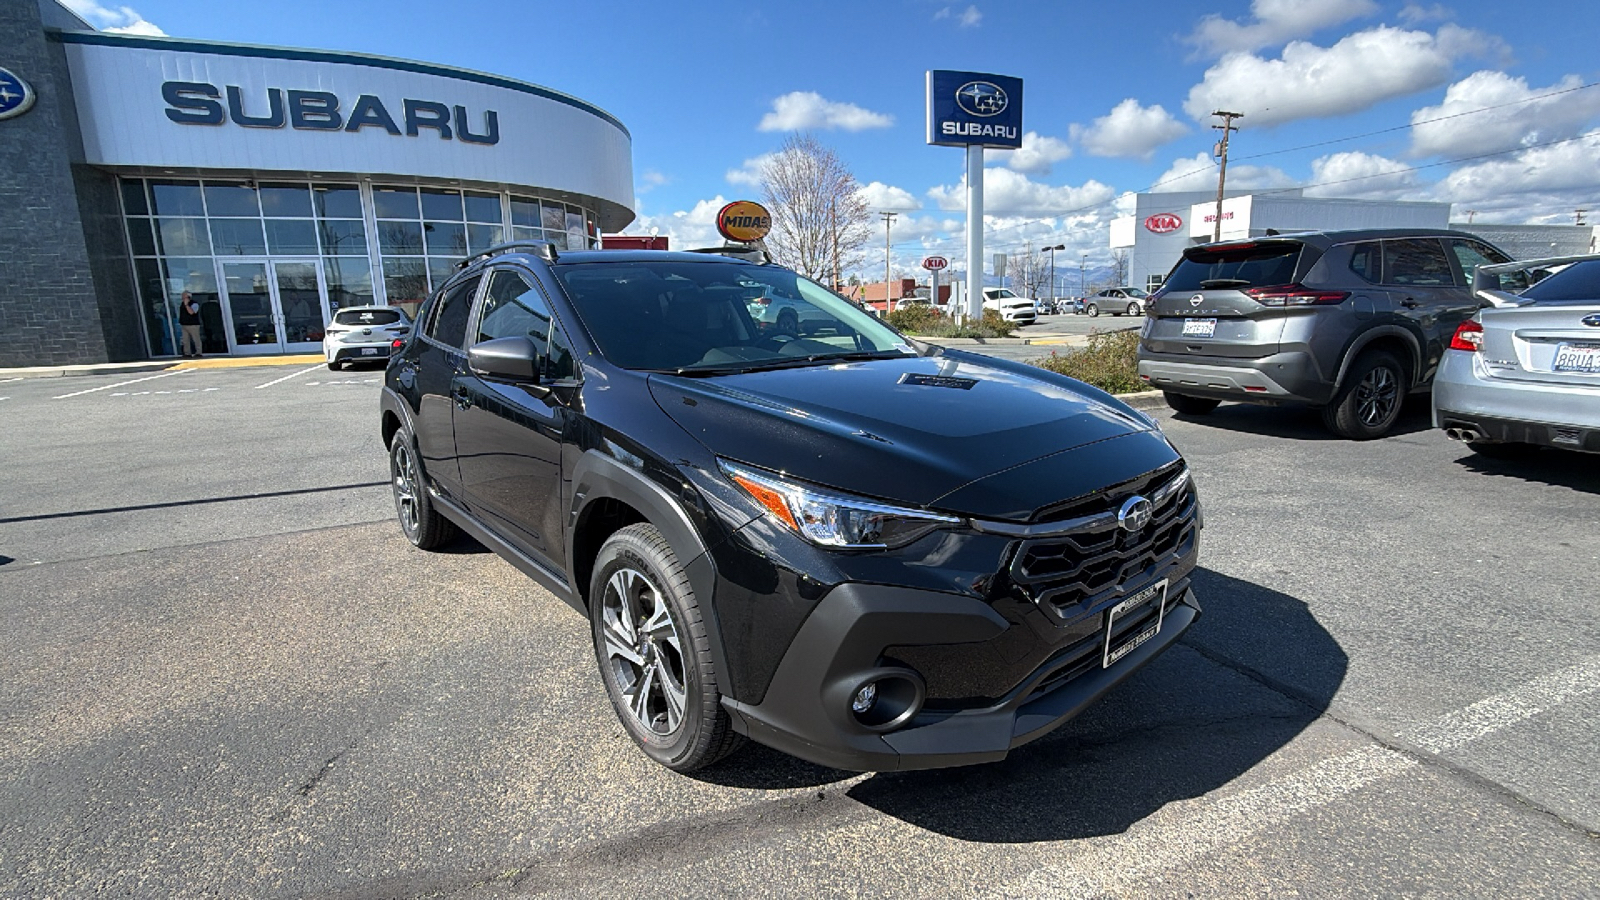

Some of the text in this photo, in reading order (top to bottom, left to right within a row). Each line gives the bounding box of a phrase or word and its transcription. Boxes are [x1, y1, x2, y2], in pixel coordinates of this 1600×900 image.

[160, 81, 500, 146] SUBARU
[942, 121, 1017, 139] SUBARU
[724, 215, 768, 228] MIDAS
[1151, 217, 1177, 229] KIA
[927, 259, 944, 268] KIA
